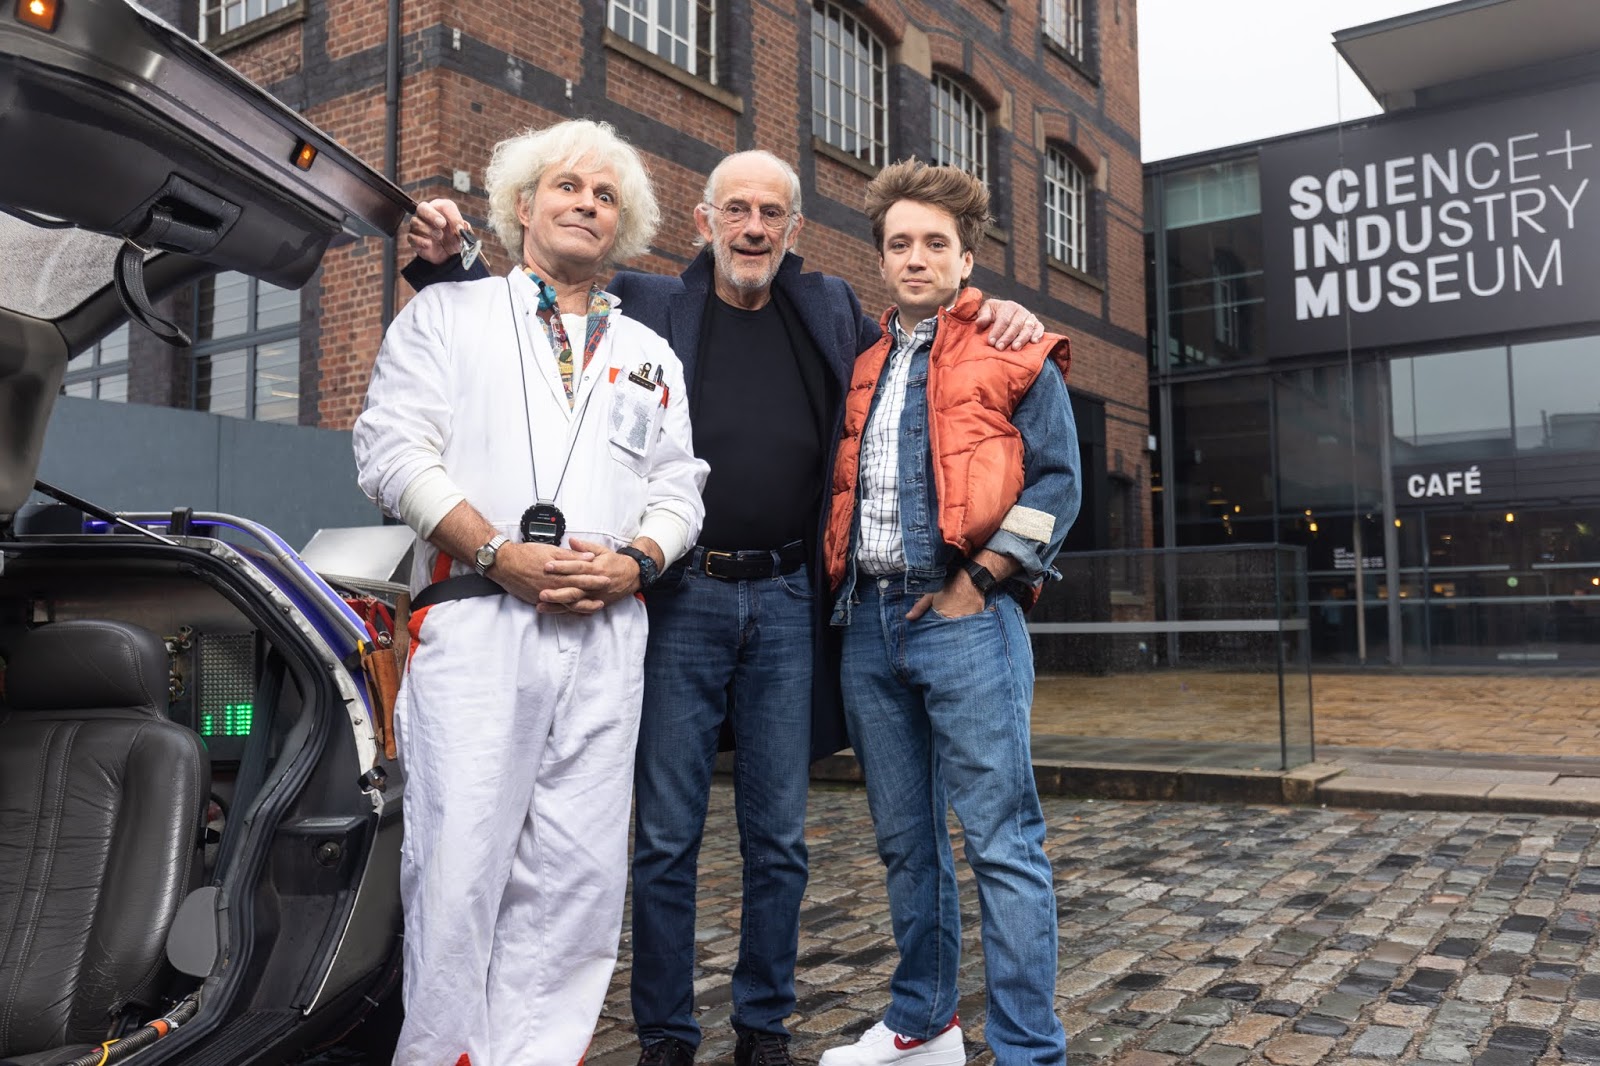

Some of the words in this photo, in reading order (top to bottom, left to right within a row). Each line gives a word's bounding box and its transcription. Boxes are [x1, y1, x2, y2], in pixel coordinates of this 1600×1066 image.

[1293, 178, 1589, 271] INDUSTRY
[1295, 238, 1563, 320] MUSEUM
[1407, 465, 1482, 498] CAFÉ
